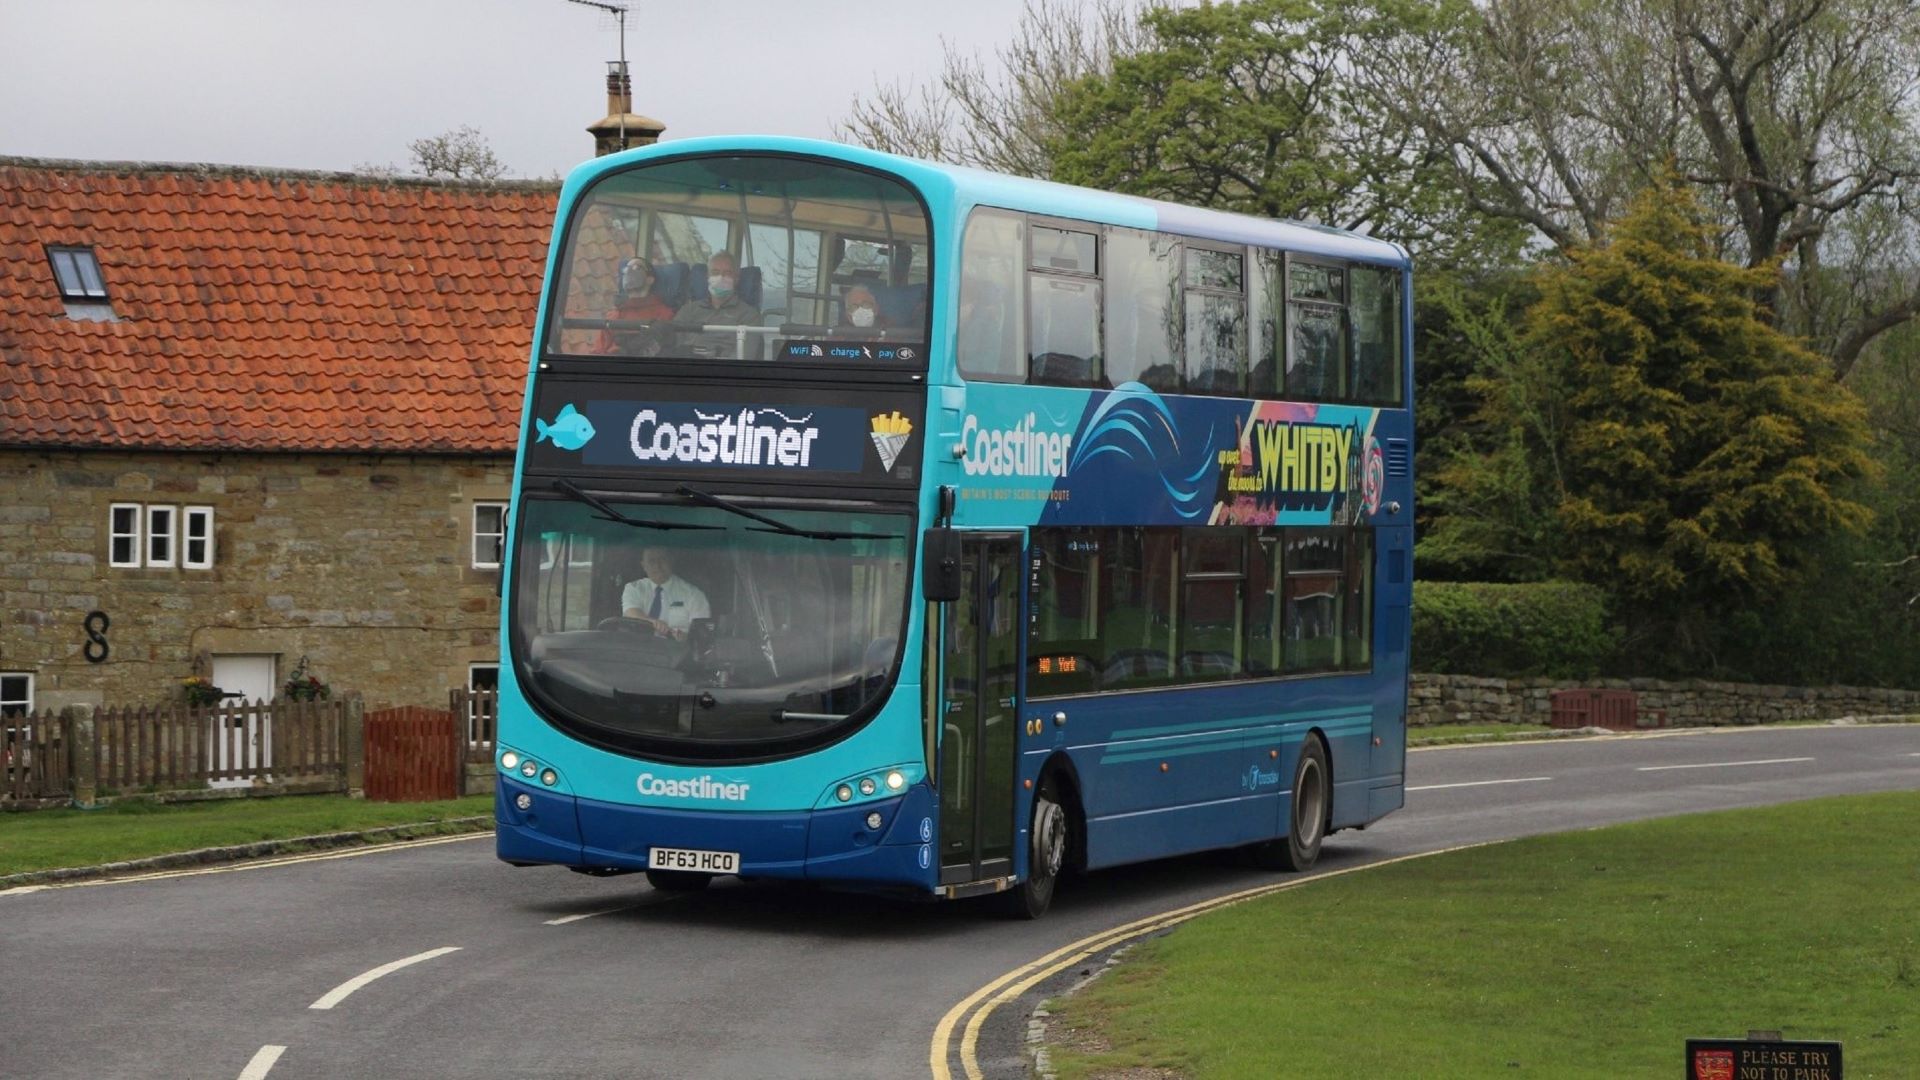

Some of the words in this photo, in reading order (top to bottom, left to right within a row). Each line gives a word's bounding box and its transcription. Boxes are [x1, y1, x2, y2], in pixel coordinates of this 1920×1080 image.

[831, 347, 860, 359] charge
[879, 349, 895, 359] pay
[630, 408, 819, 467] Coastliner
[962, 411, 1072, 478] Coastliner
[1256, 422, 1353, 493] WHITBY
[1050, 489, 1070, 501] ROUTE
[1058, 656, 1076, 672] York
[636, 772, 750, 801] Coastliner
[655, 850, 697, 868] BF63
[1742, 1050, 1797, 1065] PLEASE
[1801, 1051, 1830, 1066] TRY
[1741, 1067, 1766, 1080] NOT
[1771, 1067, 1788, 1080] TO
[1794, 1067, 1831, 1080] PARK
